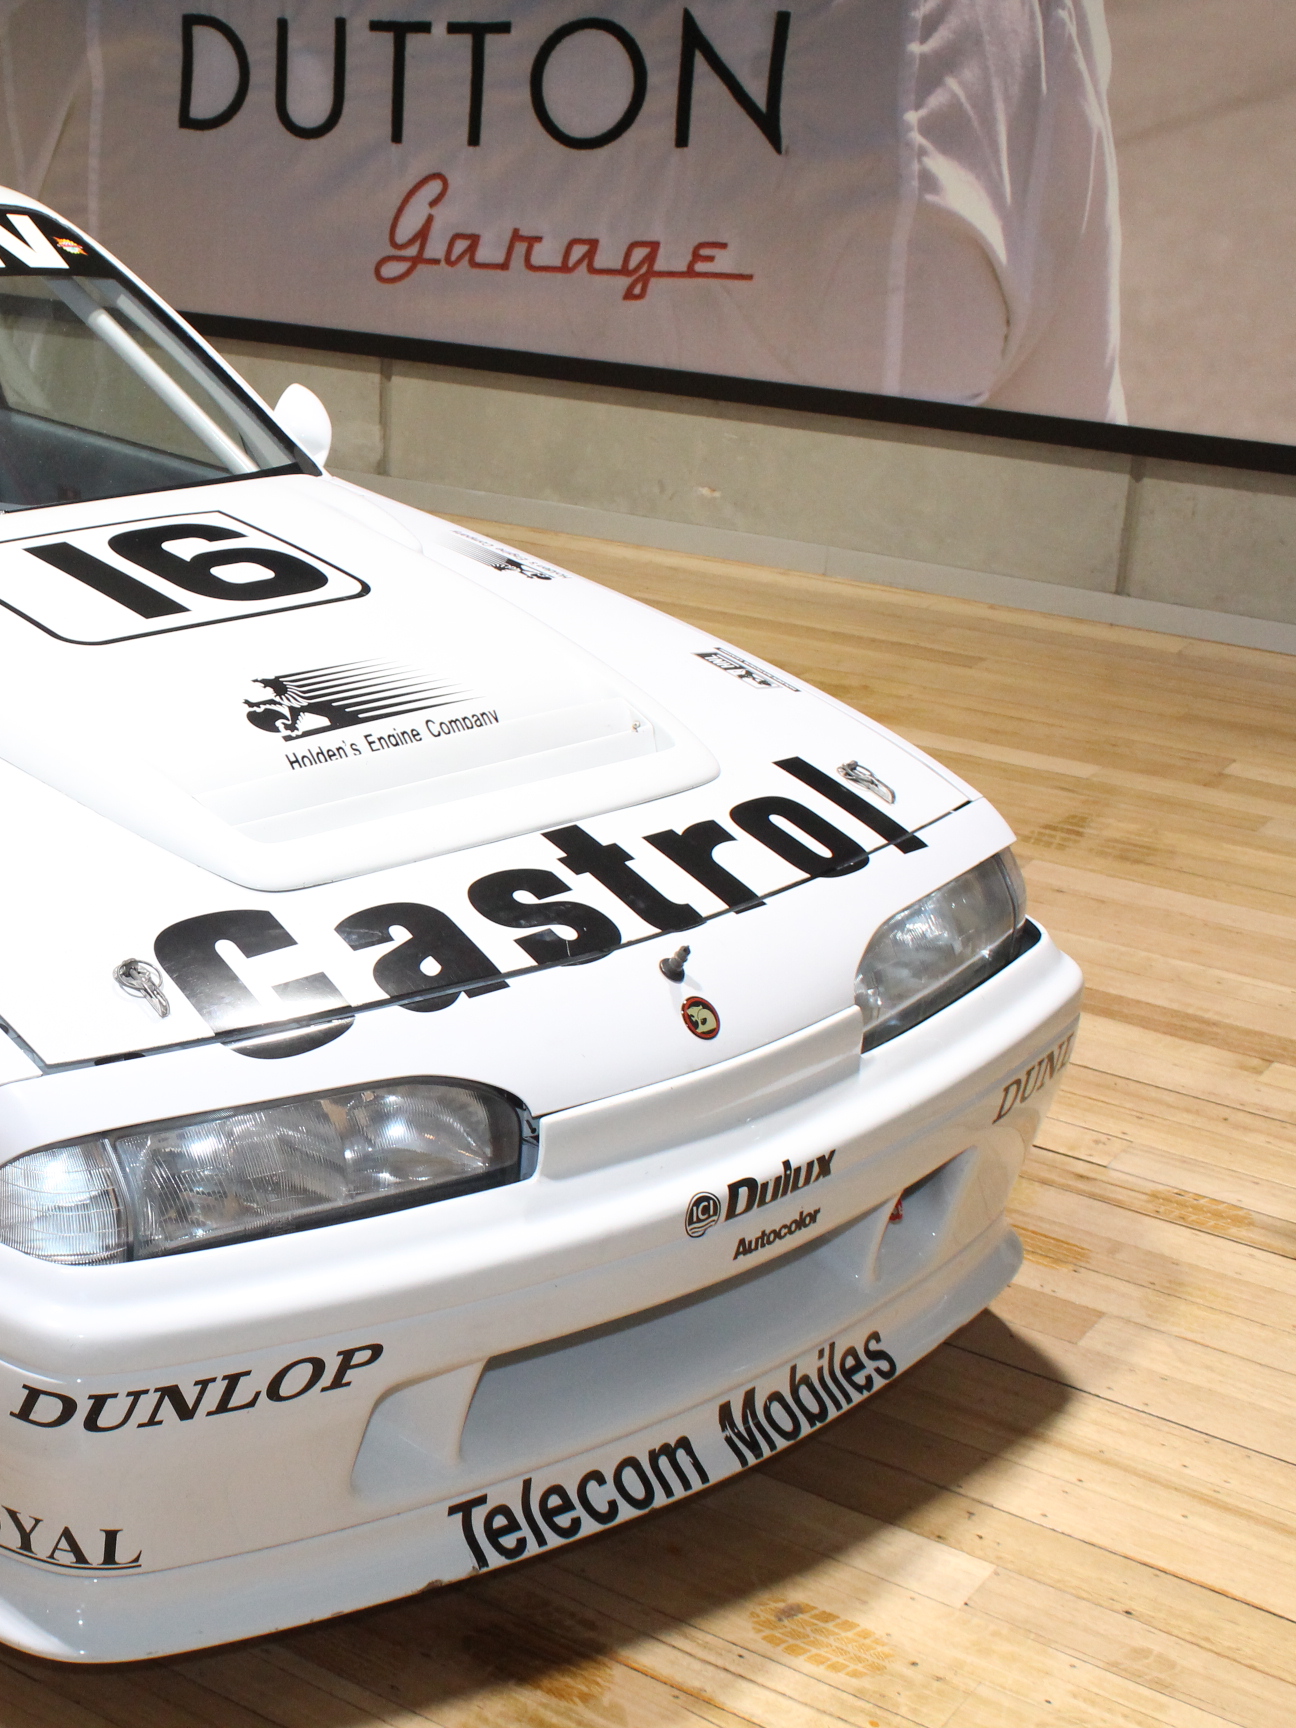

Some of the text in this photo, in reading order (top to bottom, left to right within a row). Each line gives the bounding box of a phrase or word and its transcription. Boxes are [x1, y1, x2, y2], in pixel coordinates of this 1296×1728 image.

[178, 6, 791, 154] DUTTON
[374, 172, 754, 301] Garage
[21, 523, 330, 620] 16
[284, 708, 501, 771] Holden's Engine Company
[153, 755, 928, 1060] Castrol
[724, 1149, 836, 1223] Dulux
[733, 1206, 821, 1261] Autocolor
[10, 1343, 385, 1434] DUNLOP
[447, 1330, 898, 1571] Telecom Mobiles
